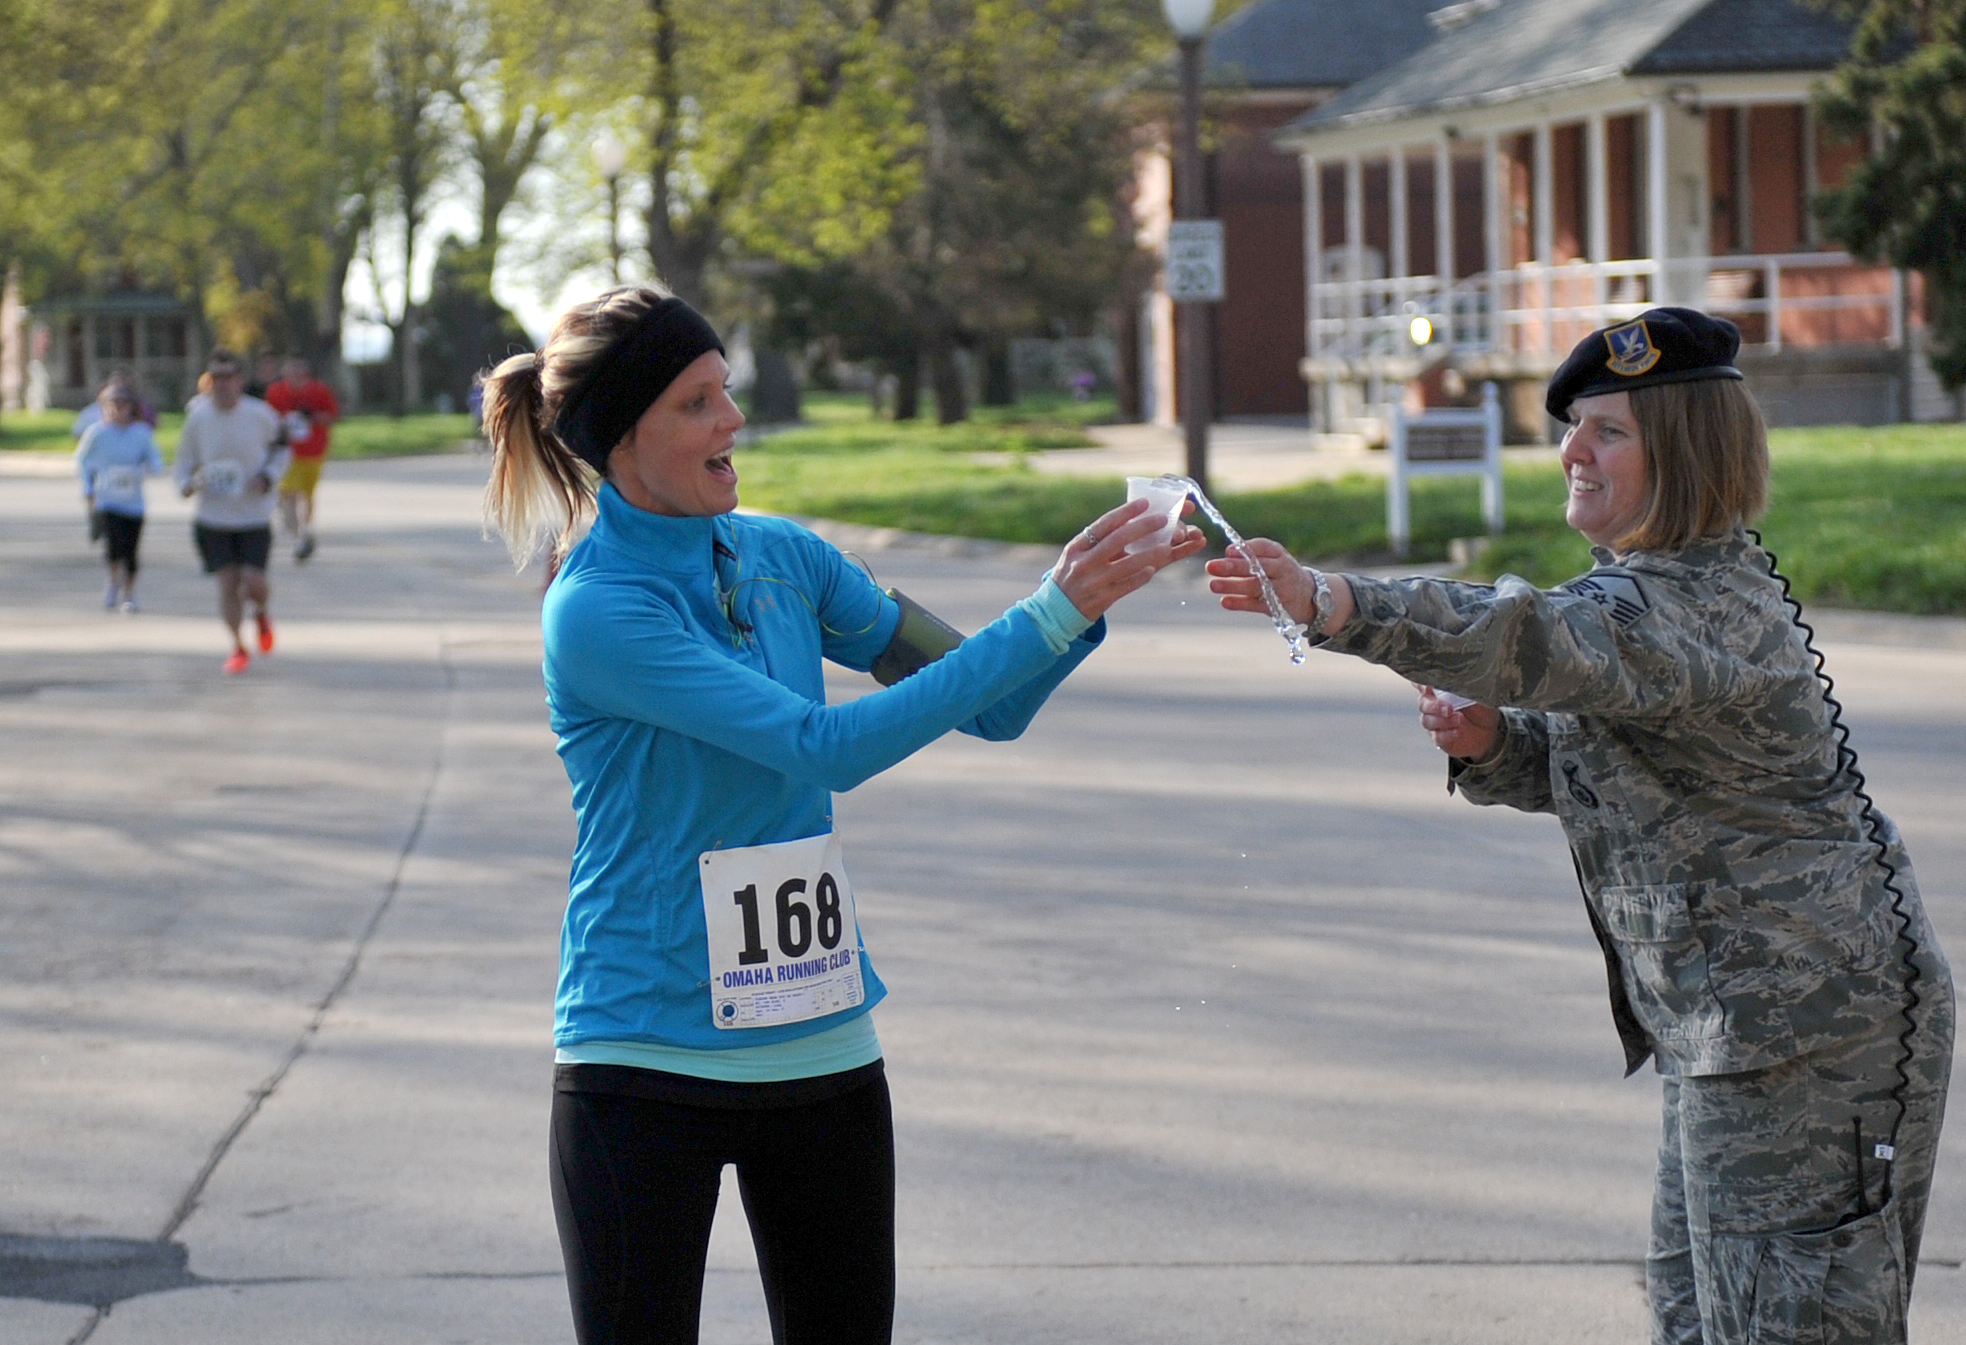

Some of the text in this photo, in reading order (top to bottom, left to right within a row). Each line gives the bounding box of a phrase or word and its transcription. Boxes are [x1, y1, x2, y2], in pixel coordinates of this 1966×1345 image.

[733, 872, 842, 966] 168
[723, 967, 774, 989] OMAHA
[777, 957, 828, 982] RUNNING
[829, 949, 851, 971] CLUB
